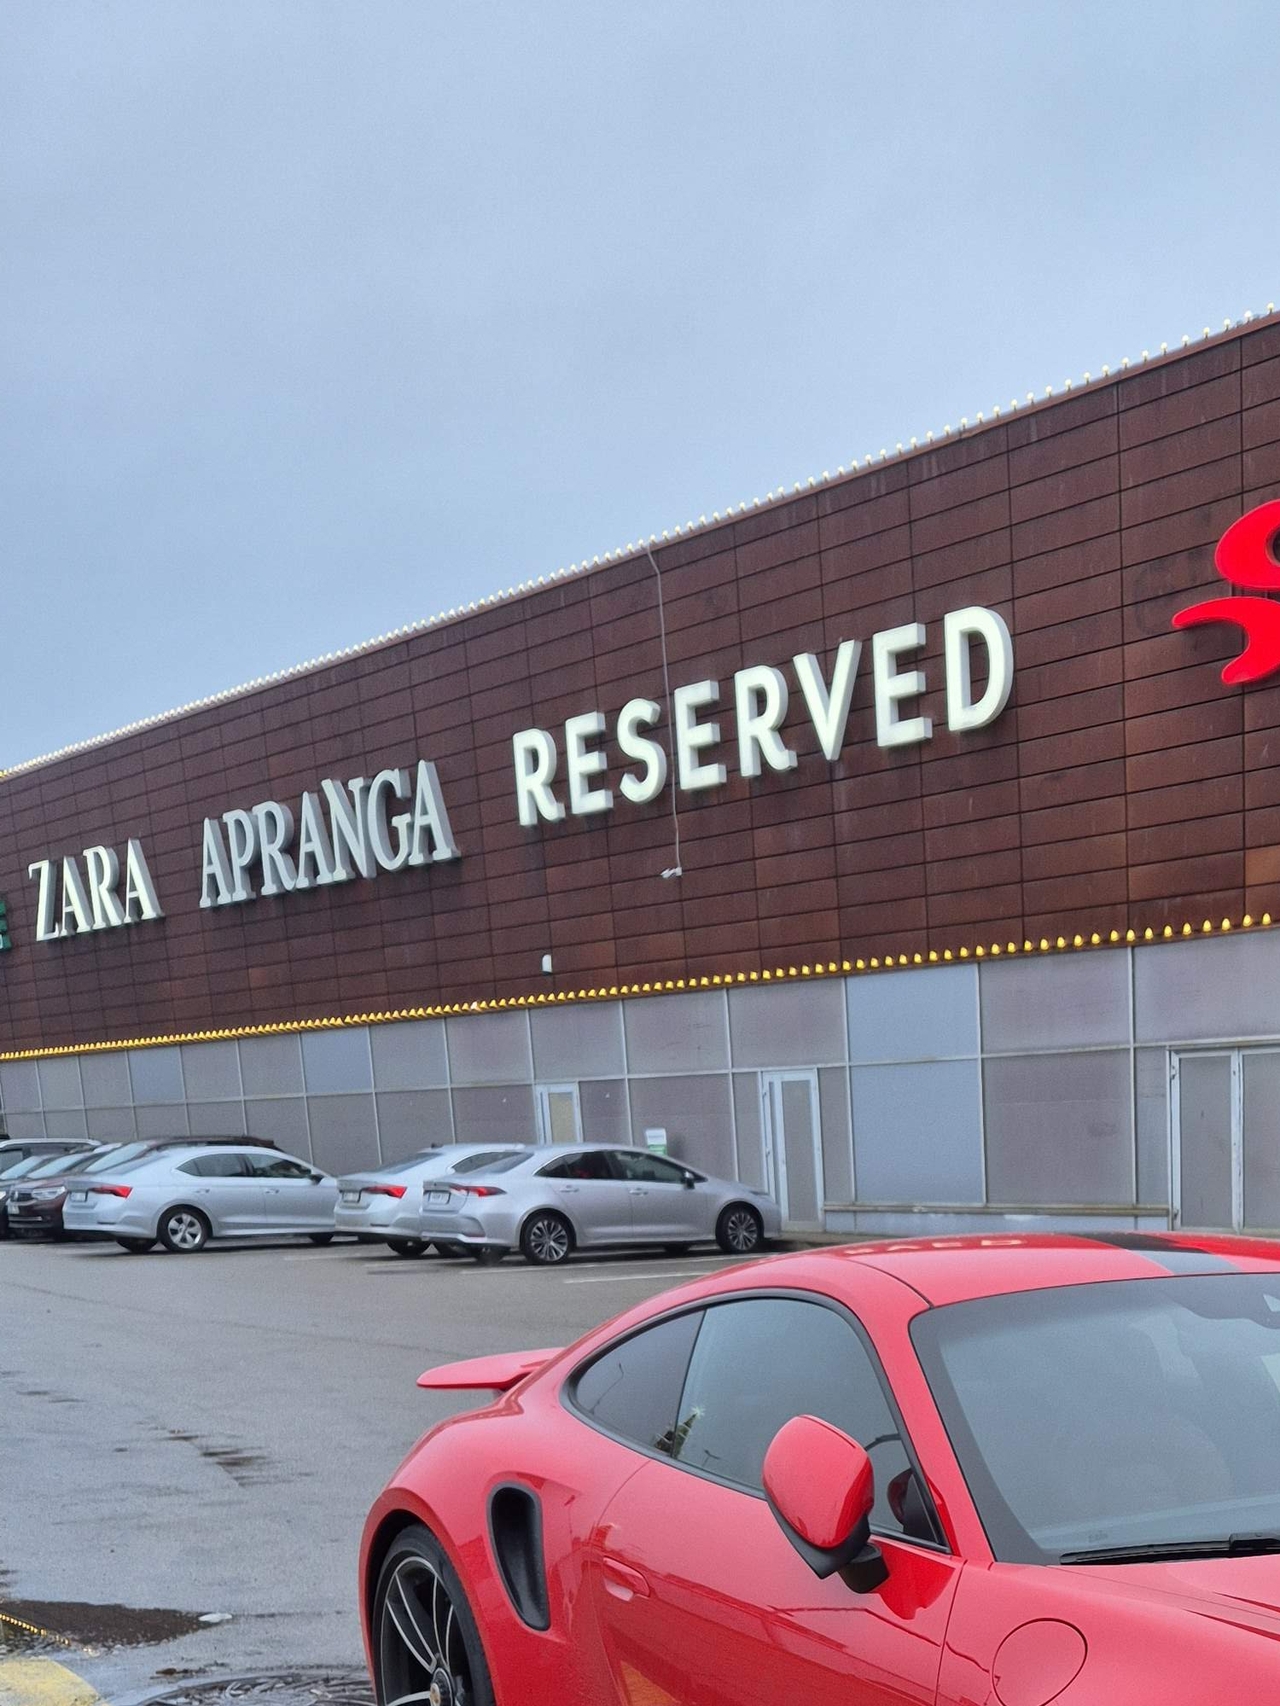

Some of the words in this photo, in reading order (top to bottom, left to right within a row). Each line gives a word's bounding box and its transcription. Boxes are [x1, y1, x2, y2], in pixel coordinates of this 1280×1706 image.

[512, 606, 1015, 826] RESERVED
[28, 838, 164, 942] ZARA
[199, 759, 461, 909] APRANGA
